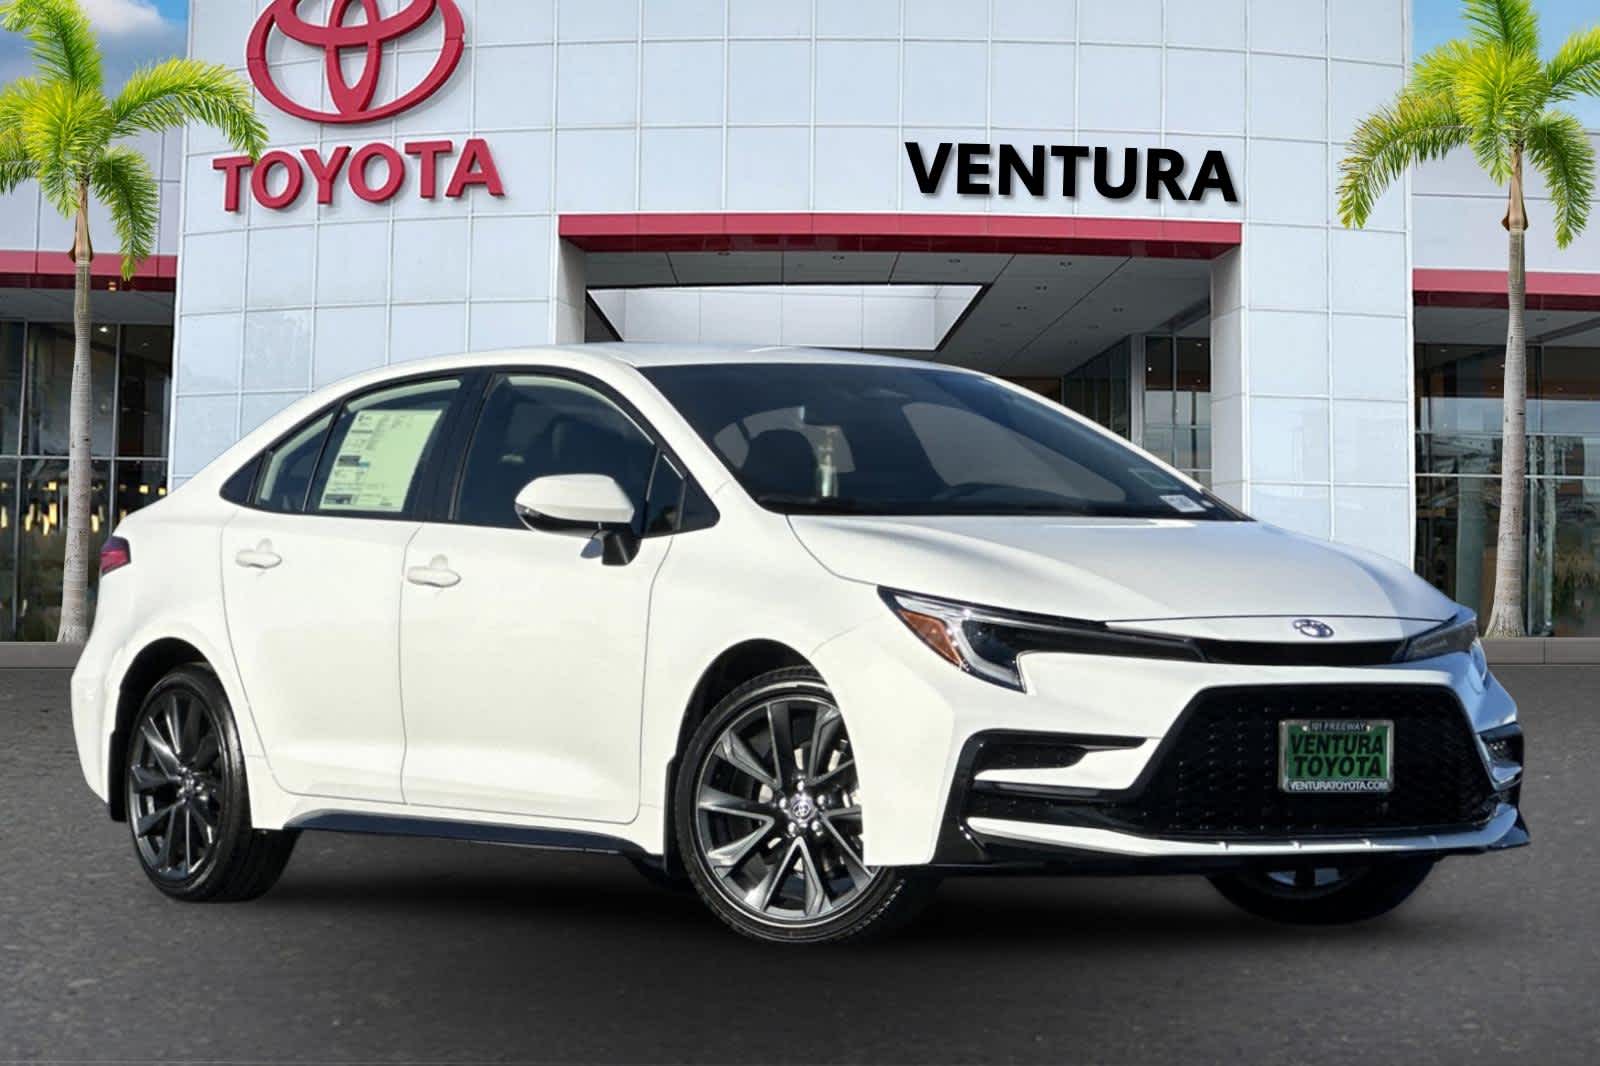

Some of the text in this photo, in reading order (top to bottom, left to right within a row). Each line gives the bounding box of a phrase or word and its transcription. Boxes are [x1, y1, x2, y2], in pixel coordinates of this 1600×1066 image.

[213, 138, 505, 212] TOYOTA
[904, 141, 1239, 203] VENTURA
[1291, 735, 1384, 755] VENTURA
[1294, 756, 1381, 777] TOYOTA
[1289, 780, 1388, 791] VENTURATOYOTA.COM
